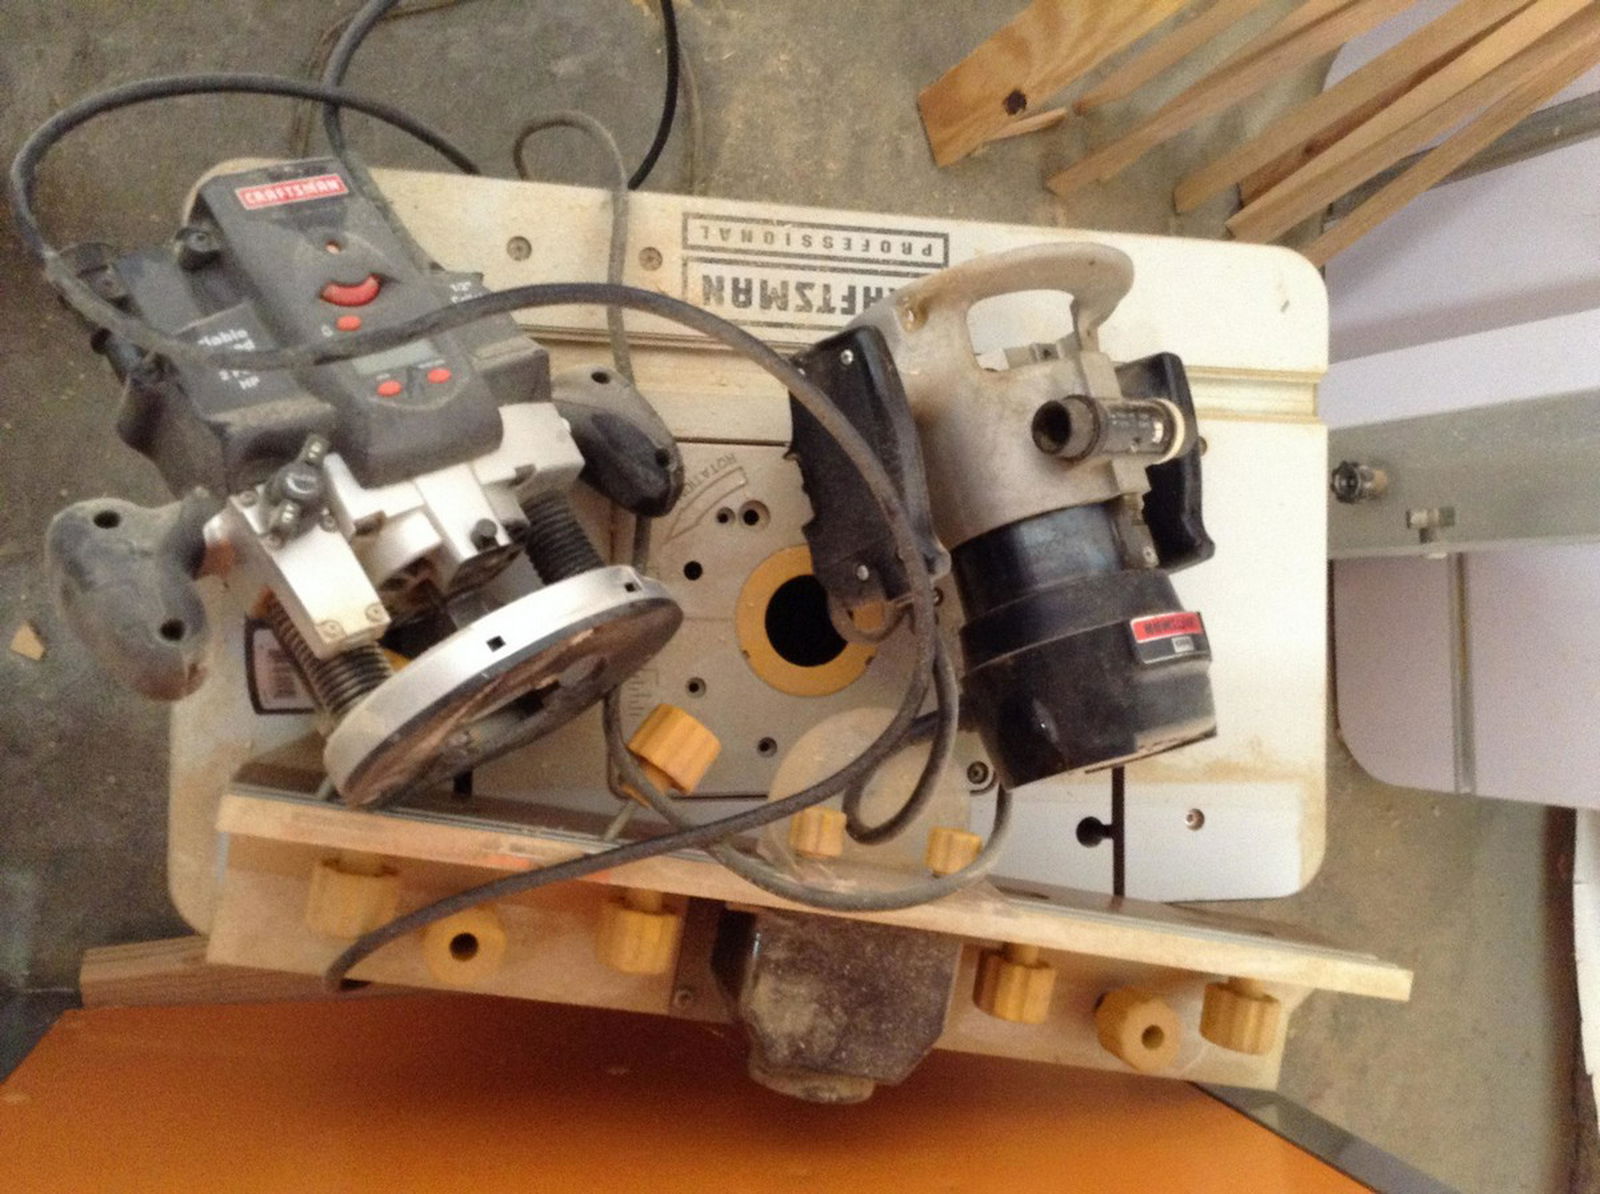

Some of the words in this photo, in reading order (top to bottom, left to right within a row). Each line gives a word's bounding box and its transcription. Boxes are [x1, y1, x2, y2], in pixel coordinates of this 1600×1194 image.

[241, 179, 341, 204] CRAFTSMAN
[699, 225, 933, 257] PROFESSIONAL
[701, 274, 896, 316] AFTSMAN
